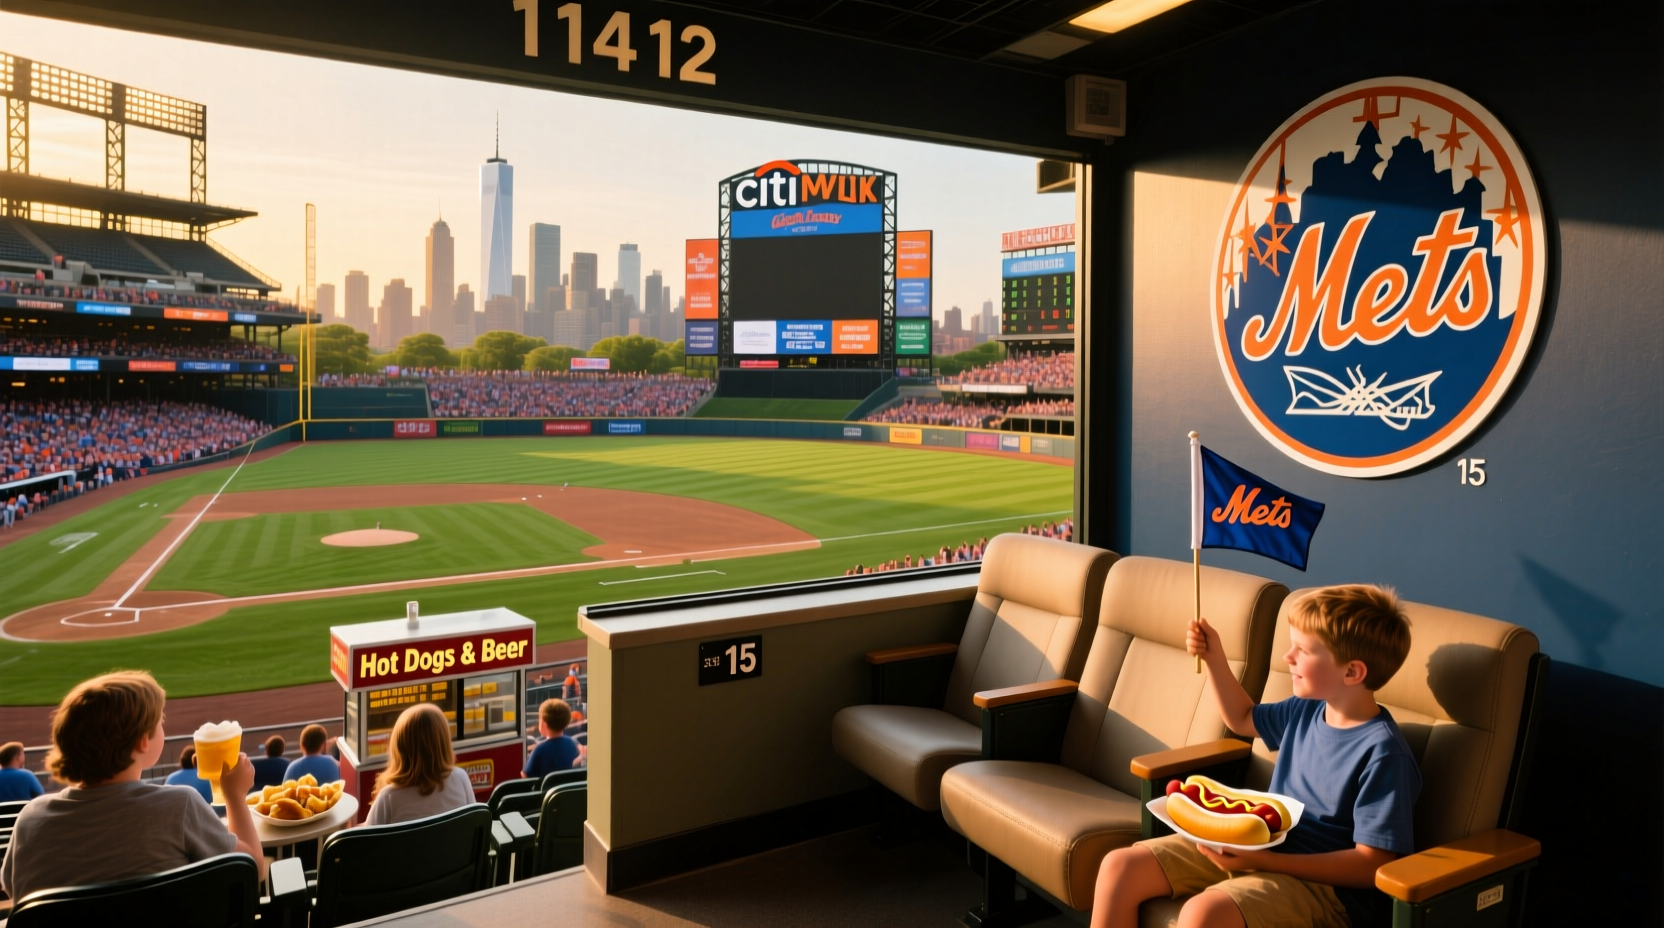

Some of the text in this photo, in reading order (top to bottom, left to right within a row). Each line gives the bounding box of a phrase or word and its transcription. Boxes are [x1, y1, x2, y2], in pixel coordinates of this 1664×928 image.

[1241, 207, 1493, 361] Mets
[1457, 458, 1486, 486] 15
[1211, 484, 1292, 529] Mets
[360, 652, 399, 678] Hot
[404, 648, 455, 674] Dogs
[460, 641, 476, 665] &
[481, 638, 528, 662] Beer
[725, 642, 757, 675] 15
